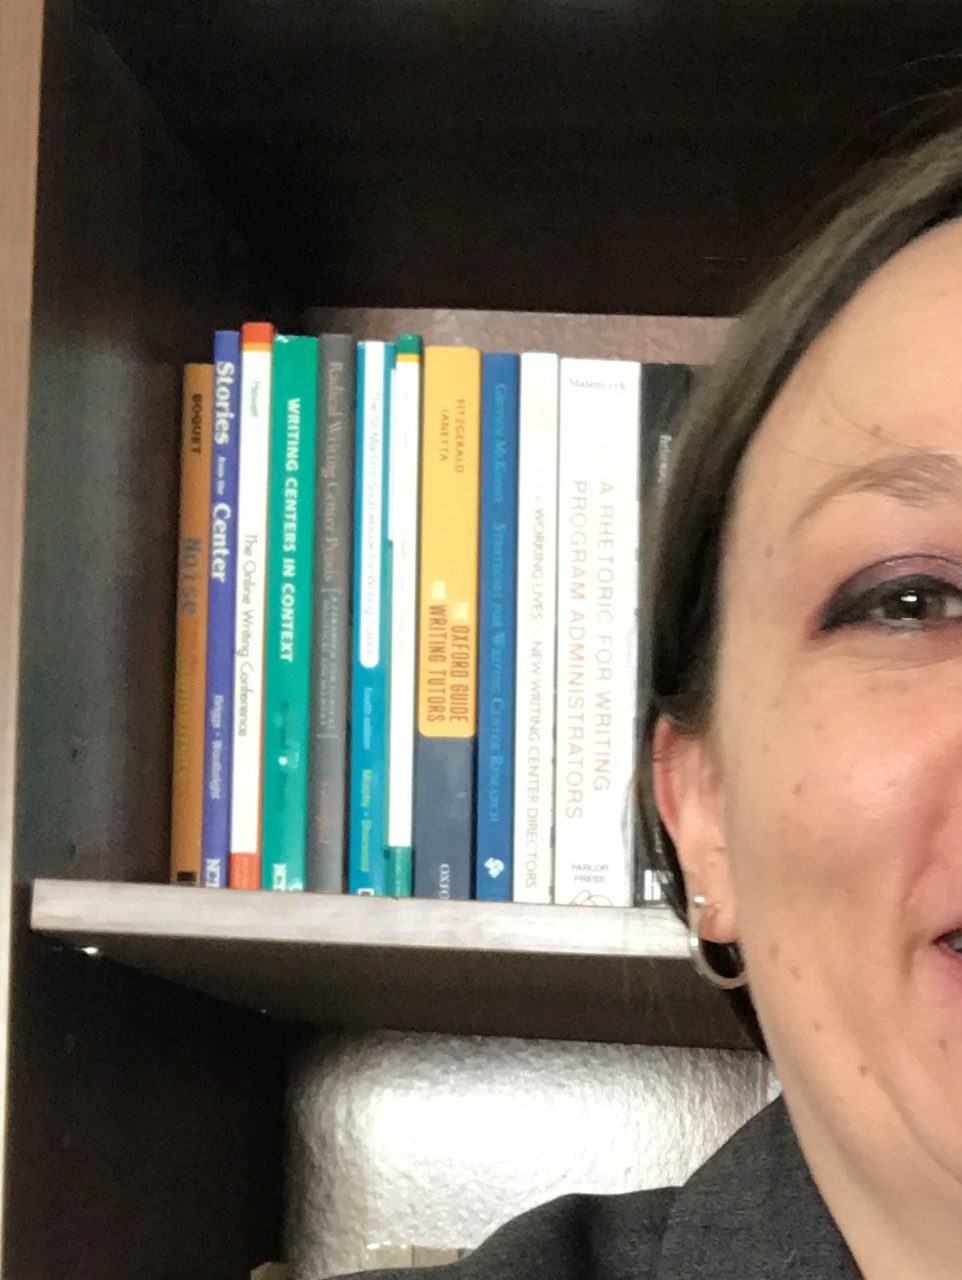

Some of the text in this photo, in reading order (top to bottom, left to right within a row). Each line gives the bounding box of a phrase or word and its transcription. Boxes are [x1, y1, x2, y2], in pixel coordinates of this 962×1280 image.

[191, 392, 204, 456] BOQUET
[214, 361, 236, 446] Stories
[453, 398, 467, 474] FITZGERALD
[211, 502, 233, 584] Center
[279, 397, 302, 663] WRITING CENTERS IN CONTEXT
[236, 534, 259, 738] The Online Writing Conference
[426, 604, 448, 723] WRITING TUTORS
[448, 625, 470, 723] OXFORD GUIDE
[565, 480, 588, 820] PROGRAM ADMINISTRATORS
[593, 481, 615, 792] A RHETORIC FOR WRITING
[524, 508, 546, 889] WORKING LIVES NEW WRITING CENTER DIRECTORS
